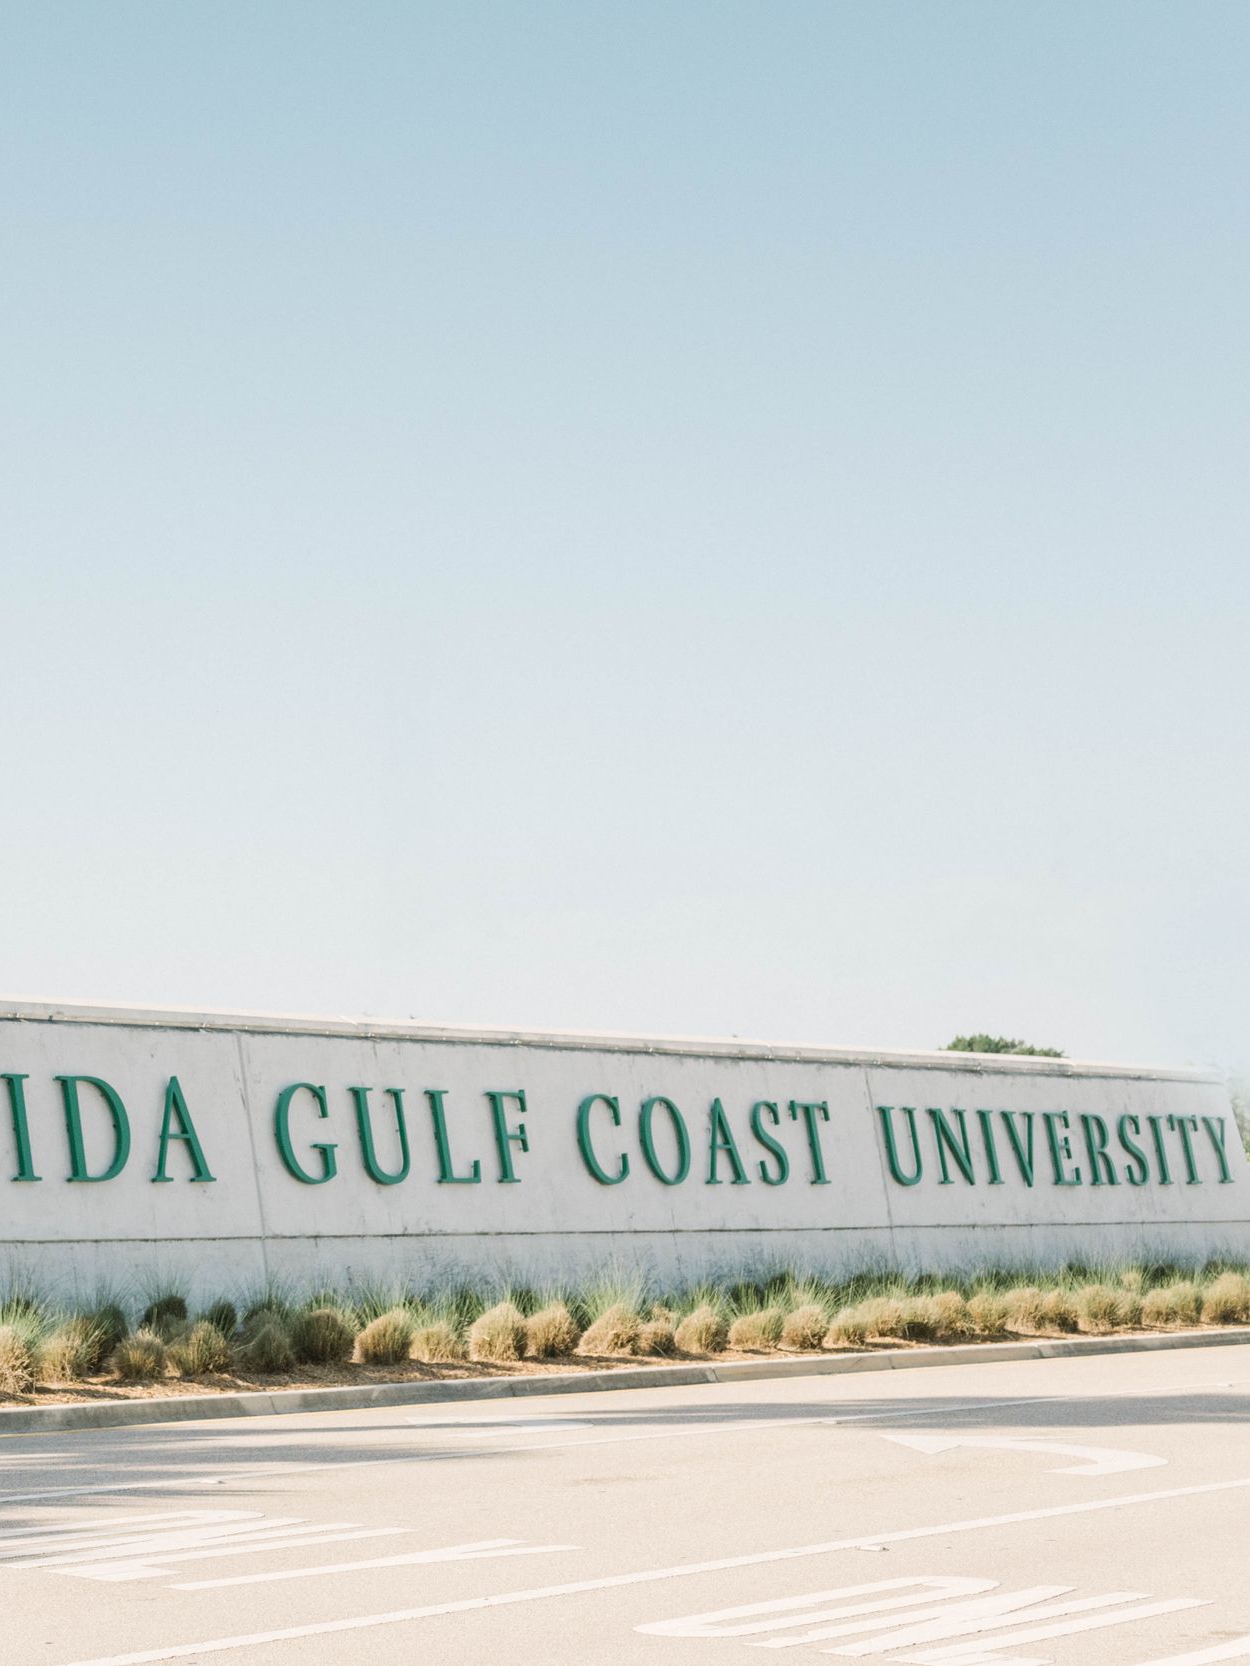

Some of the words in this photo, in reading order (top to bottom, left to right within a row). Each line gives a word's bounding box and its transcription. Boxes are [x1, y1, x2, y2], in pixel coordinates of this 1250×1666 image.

[274, 1082, 529, 1185] GULF
[577, 1093, 831, 1186] COAST
[877, 1106, 1234, 1187] UNIVERSITY
[632, 1575, 1250, 1666] ONL
